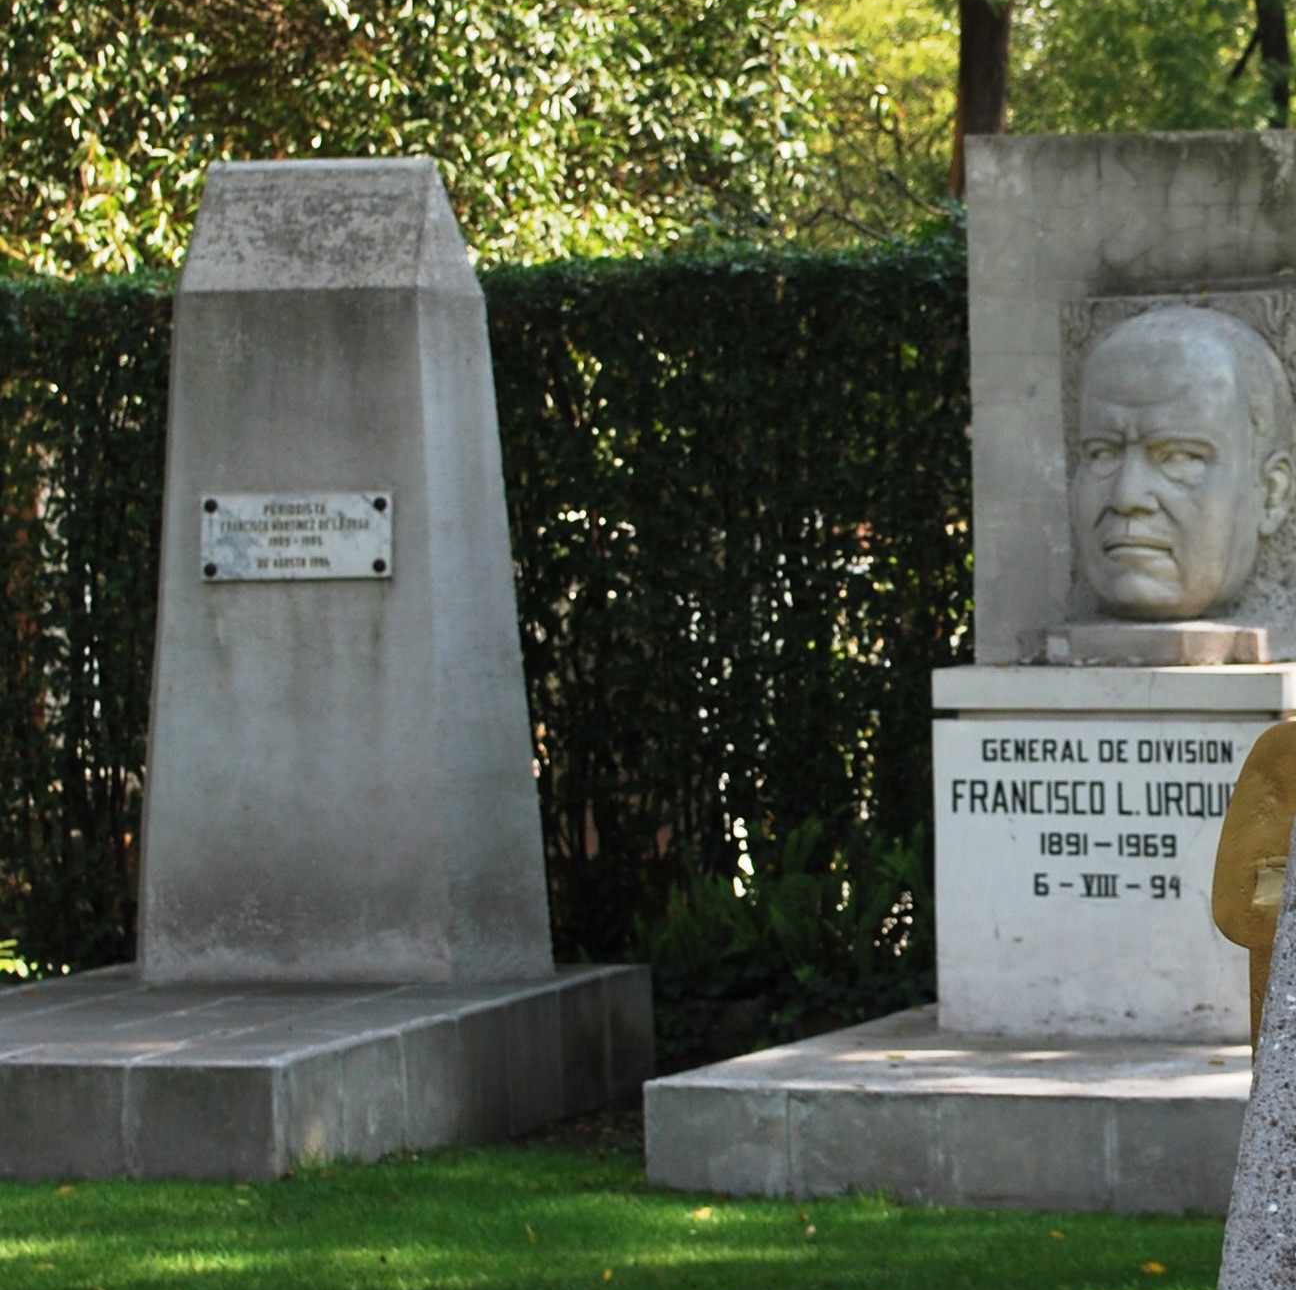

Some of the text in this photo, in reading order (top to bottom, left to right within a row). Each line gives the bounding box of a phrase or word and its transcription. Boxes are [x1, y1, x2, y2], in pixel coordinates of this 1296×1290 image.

[982, 738, 1234, 764] GENERAL DE DIVISION
[951, 779, 1237, 820] FRANCISCO L. URQUI
